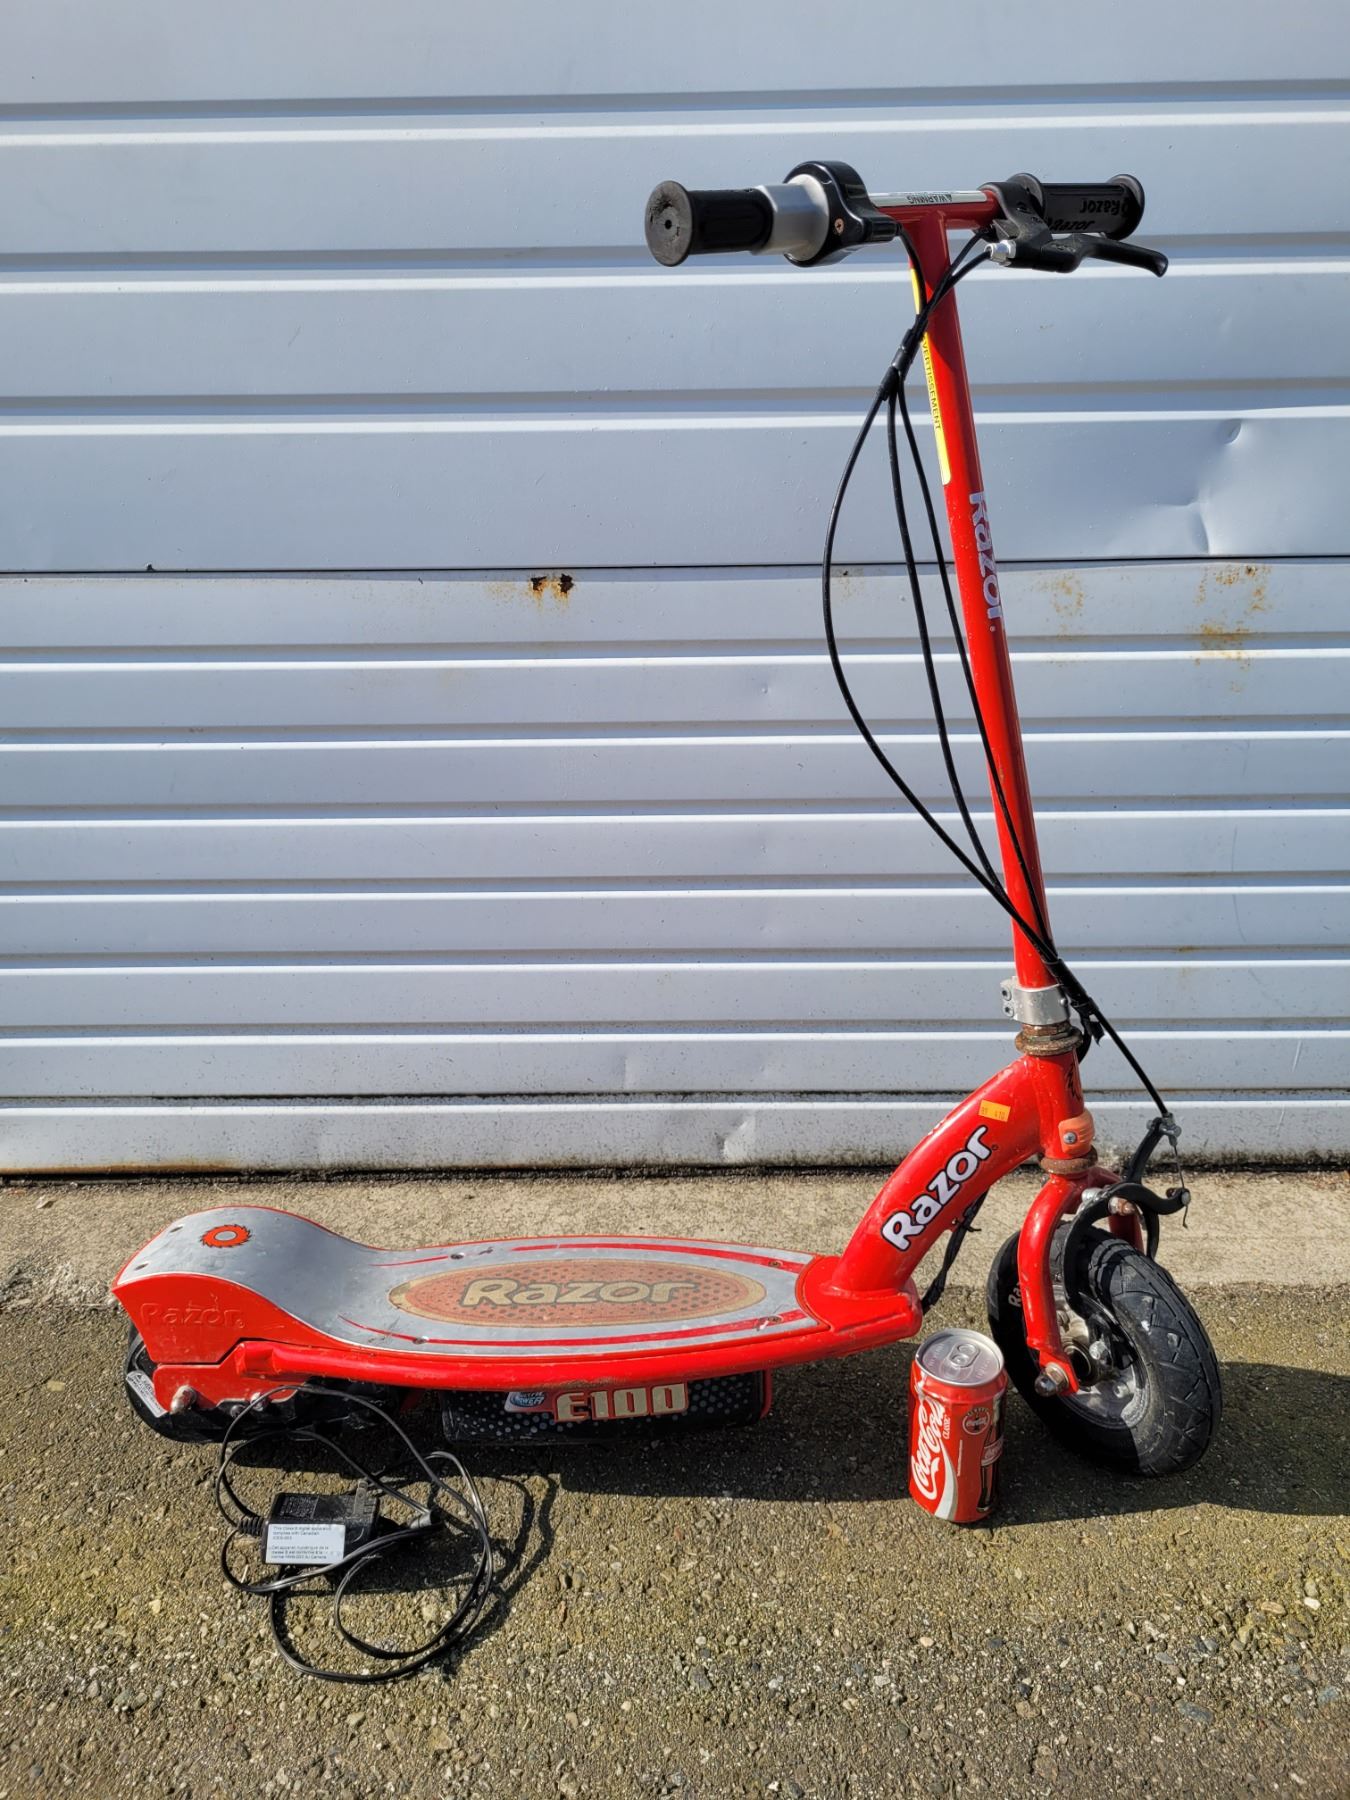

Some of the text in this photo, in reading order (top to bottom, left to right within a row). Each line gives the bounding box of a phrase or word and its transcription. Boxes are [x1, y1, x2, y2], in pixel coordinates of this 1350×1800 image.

[1079, 200, 1121, 217] Razor
[921, 337, 942, 430] VERTISSEMENT
[969, 491, 1006, 620] Razor
[881, 1124, 992, 1252] Razor
[460, 1277, 698, 1307] Razor
[139, 1301, 239, 1328] Razor
[556, 1384, 687, 1421] E100
